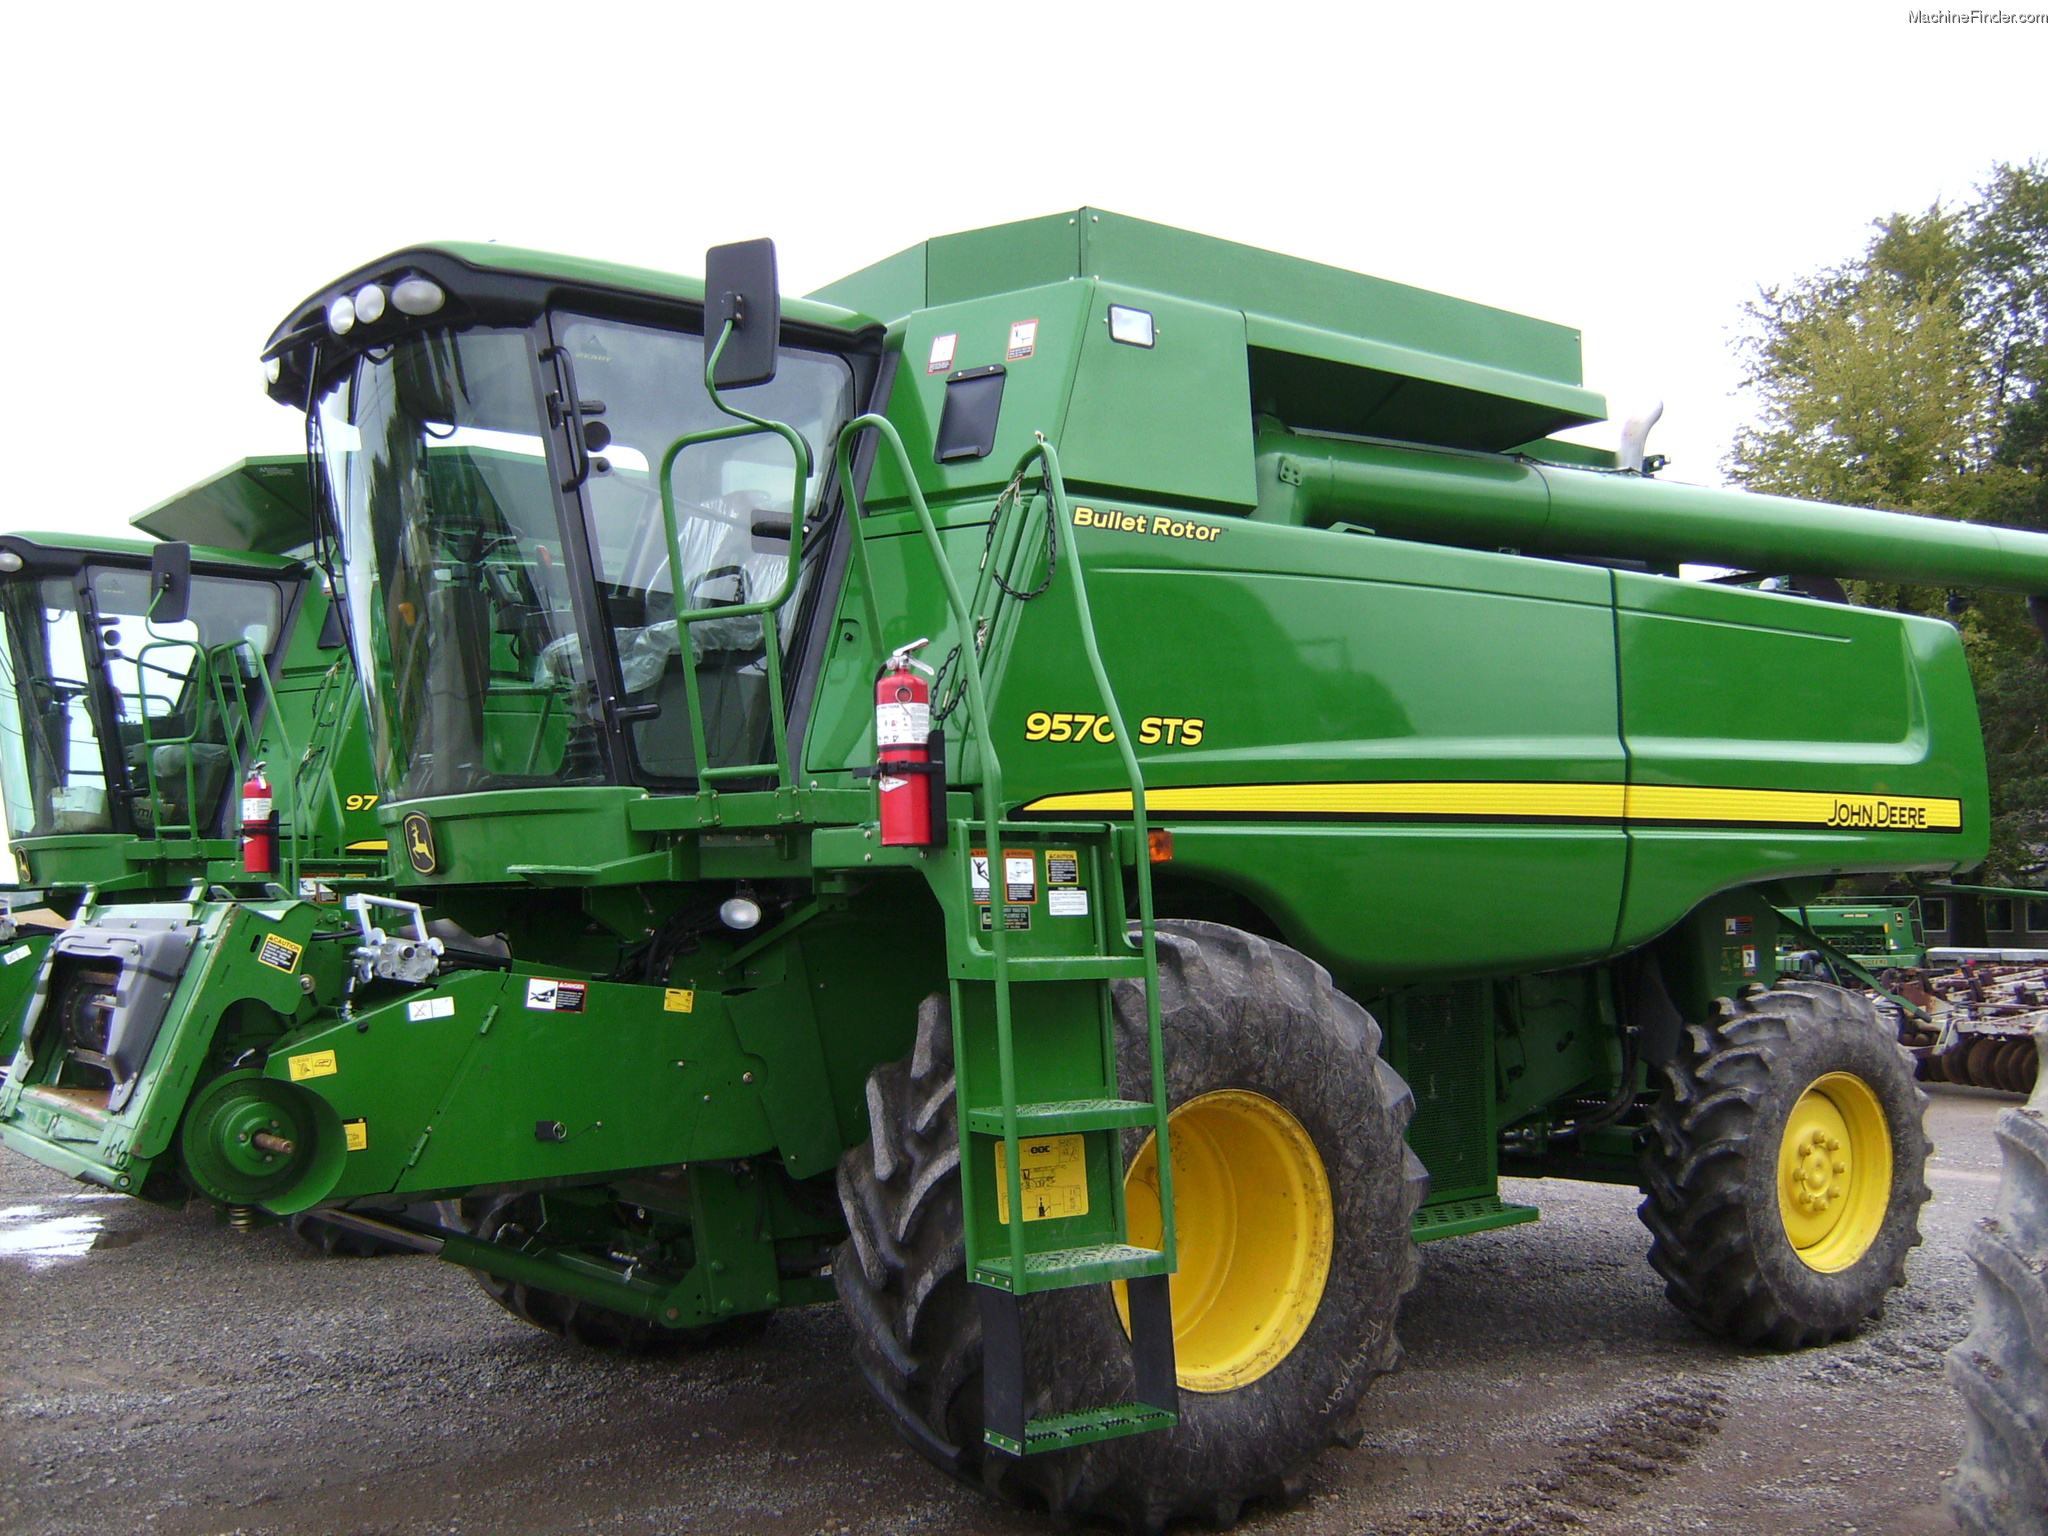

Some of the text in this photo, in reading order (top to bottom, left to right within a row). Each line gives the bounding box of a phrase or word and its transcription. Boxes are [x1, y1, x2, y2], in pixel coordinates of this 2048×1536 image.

[1072, 506, 1149, 534] Bullet
[1024, 711, 1205, 747] 9570 STS
[345, 794, 379, 812] 97
[1828, 799, 1926, 826] JOHN DEERE
[273, 936, 300, 951] CAUTION
